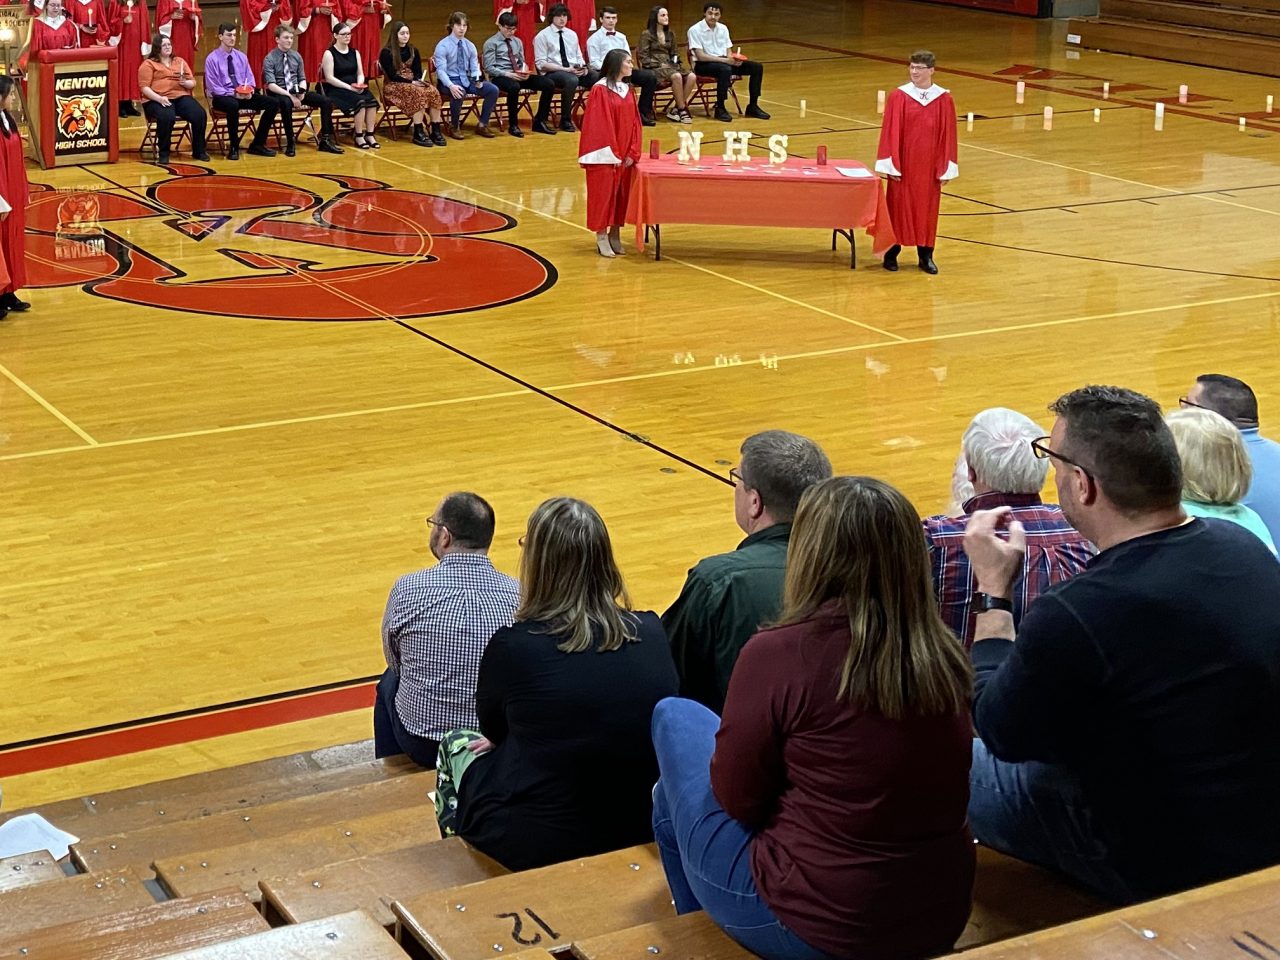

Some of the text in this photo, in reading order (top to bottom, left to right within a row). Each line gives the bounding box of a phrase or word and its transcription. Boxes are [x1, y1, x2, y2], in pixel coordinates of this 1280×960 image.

[55, 76, 107, 91] KENTON
[55, 138, 107, 150] HIGH SCHOOL
